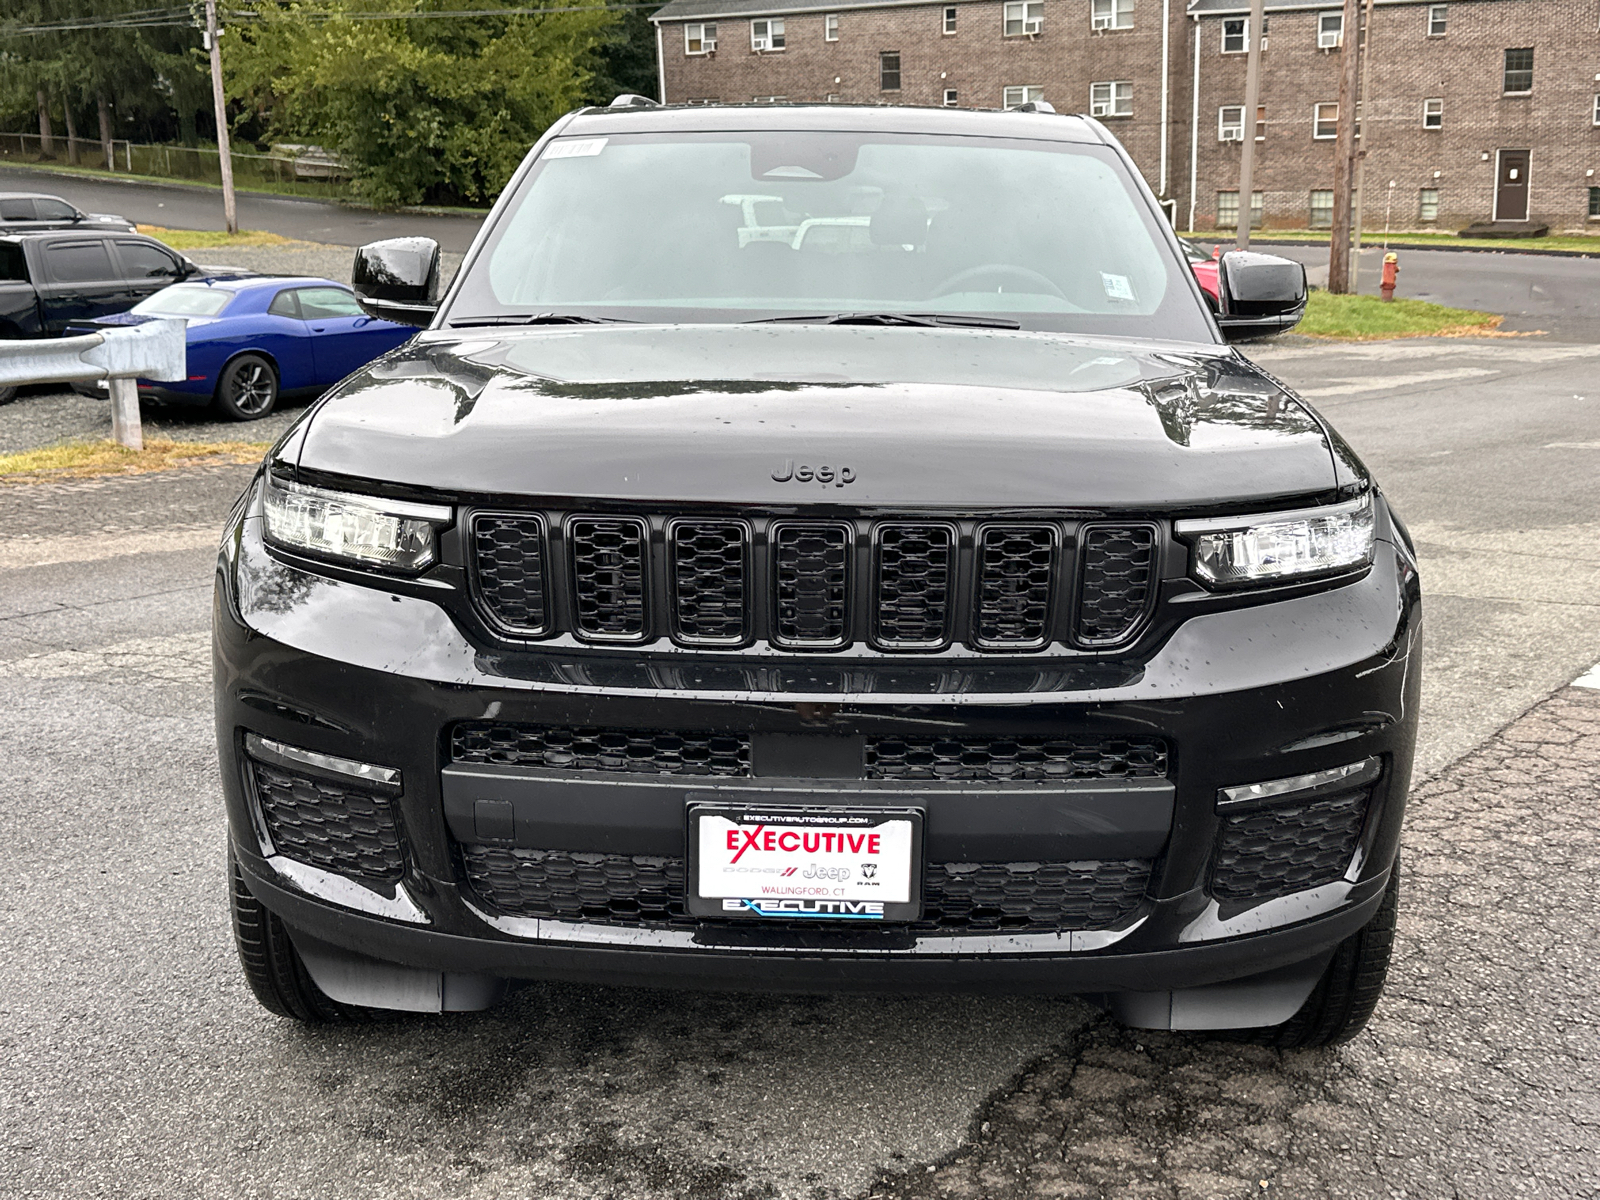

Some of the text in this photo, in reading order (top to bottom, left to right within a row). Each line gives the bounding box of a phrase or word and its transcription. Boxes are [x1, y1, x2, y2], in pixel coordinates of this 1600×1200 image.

[770, 459, 857, 488] Jeep
[743, 815, 869, 824] EXECUTIVEAUTOGROUP.COM
[726, 825, 881, 864] EXECUTIVE
[802, 863, 851, 882] Jeep
[833, 887, 846, 896] CT
[722, 898, 885, 916] EXECUTIVE
